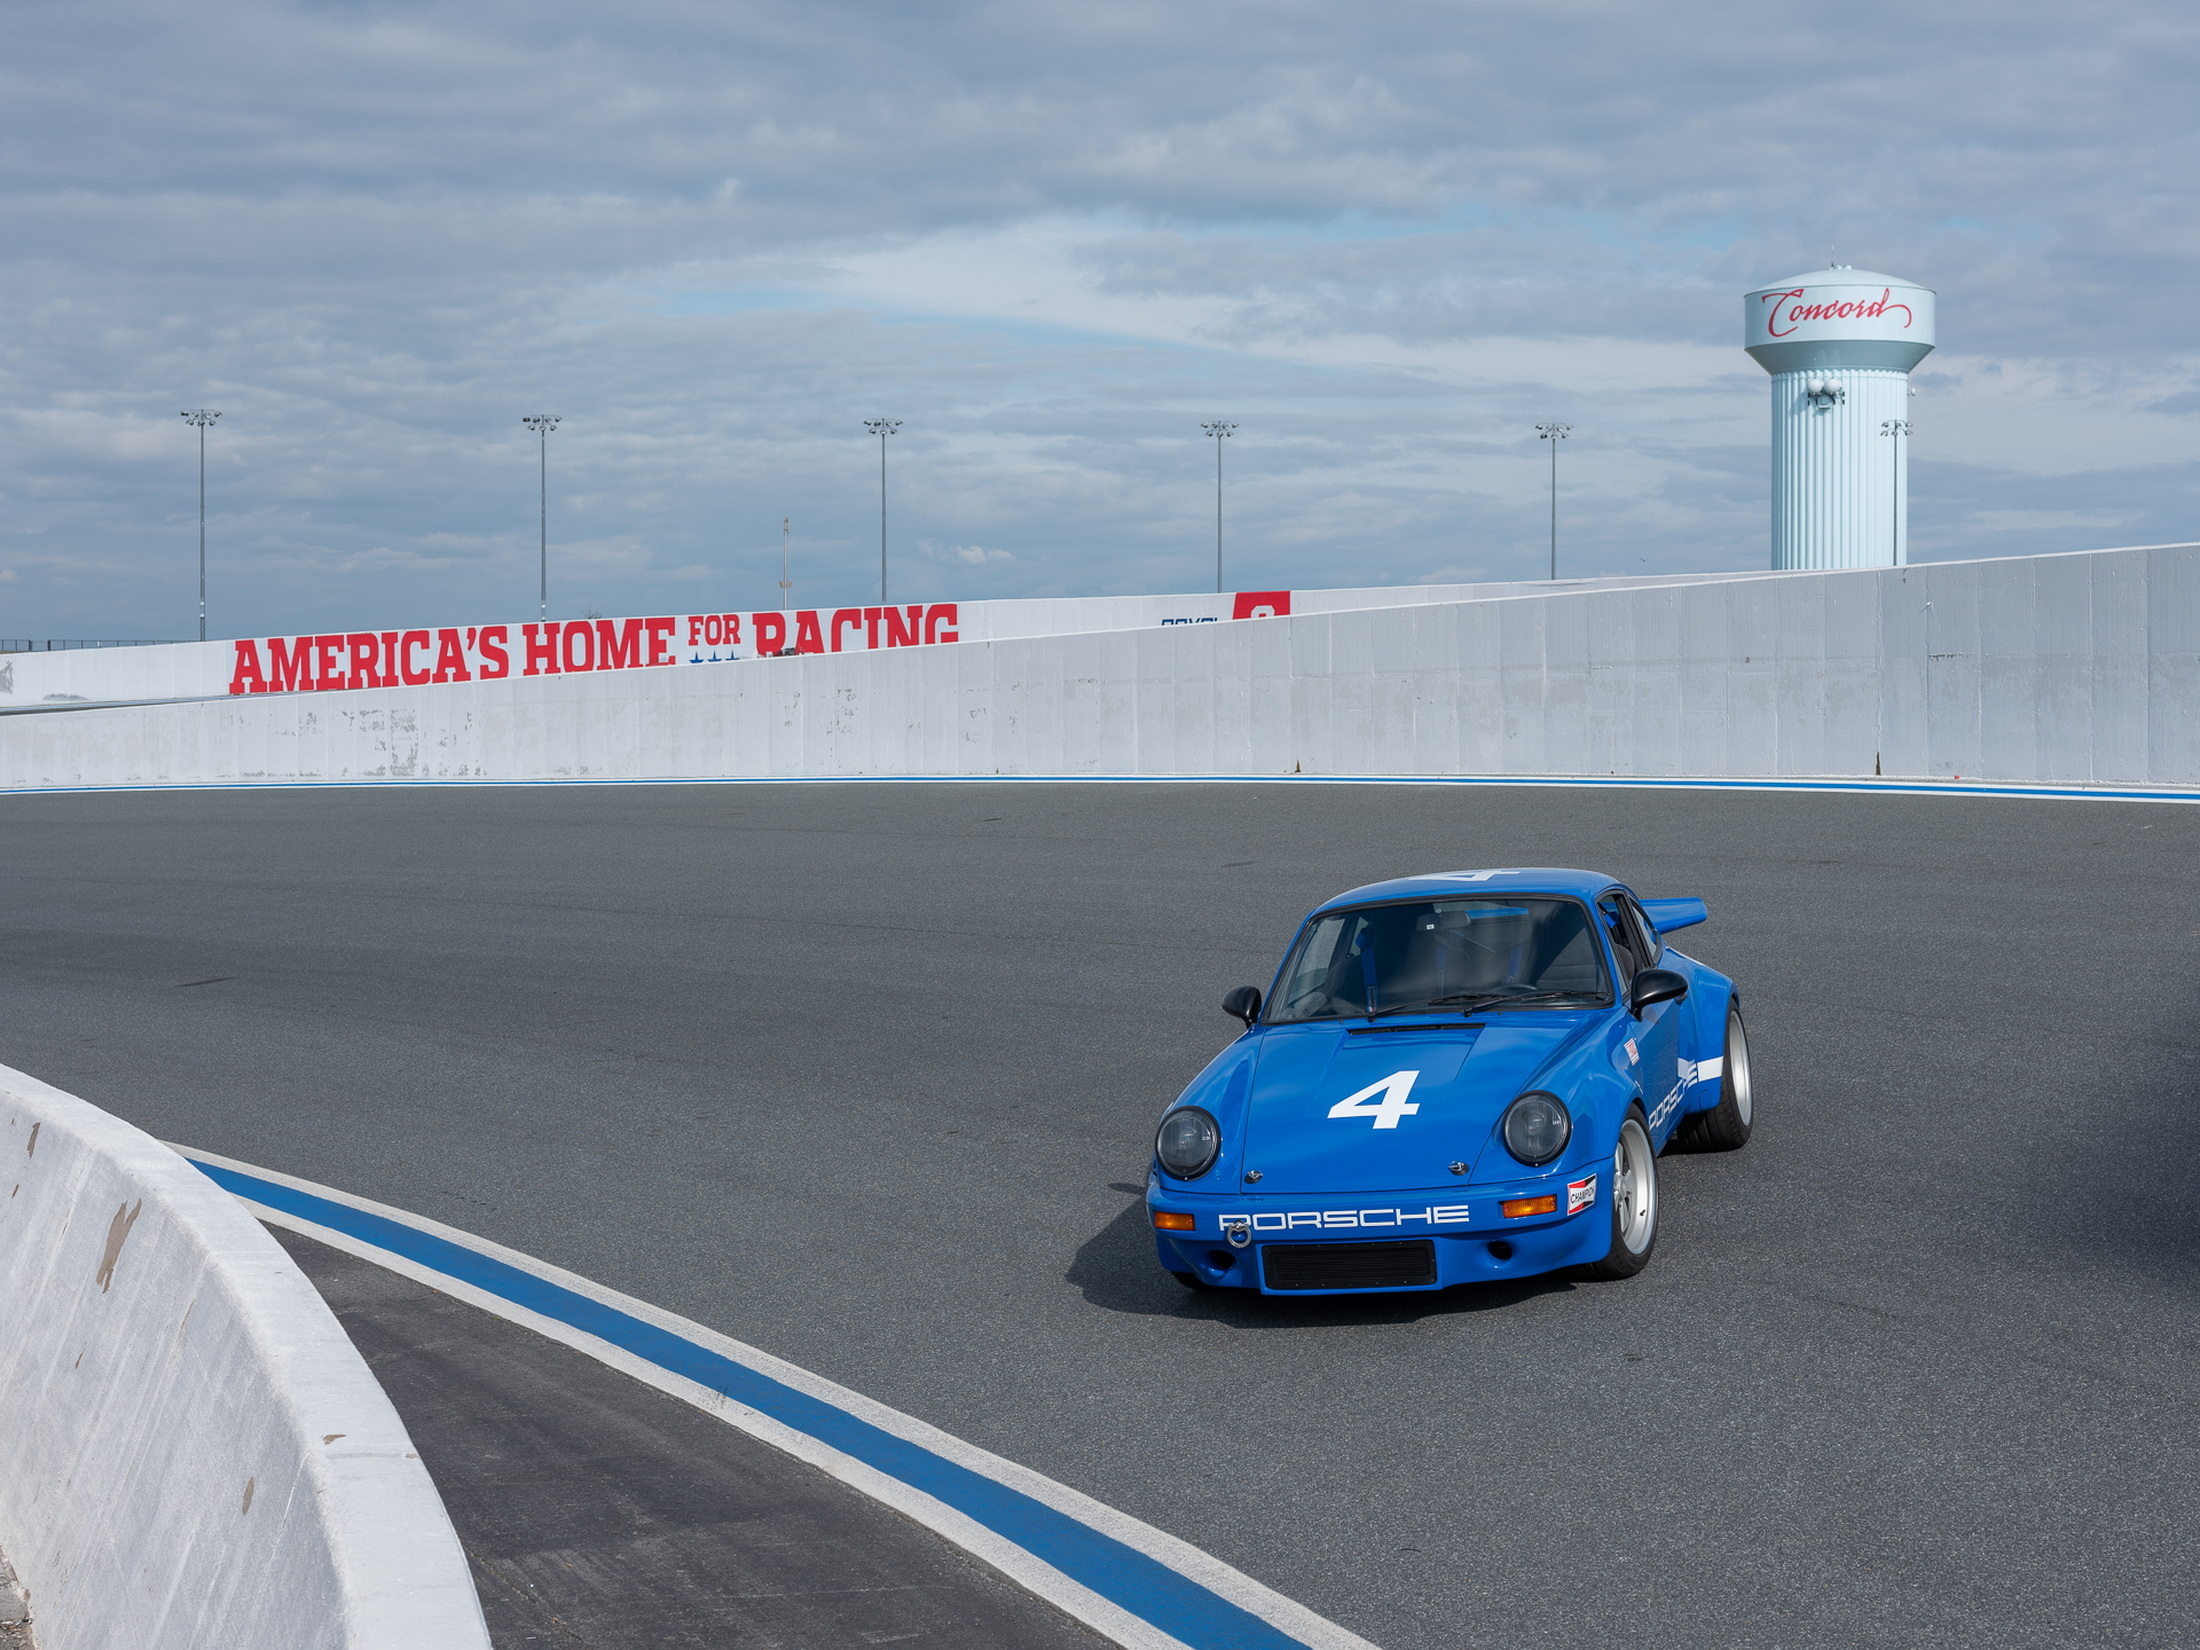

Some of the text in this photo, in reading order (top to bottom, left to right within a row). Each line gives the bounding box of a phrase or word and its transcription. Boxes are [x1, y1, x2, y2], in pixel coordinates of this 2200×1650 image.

[1761, 287, 1912, 337] Concord
[229, 603, 959, 695] AMERICA'S HOME FOR RACING
[1327, 1070, 1420, 1129] 4
[1218, 1205, 1470, 1231] PORSCHE
